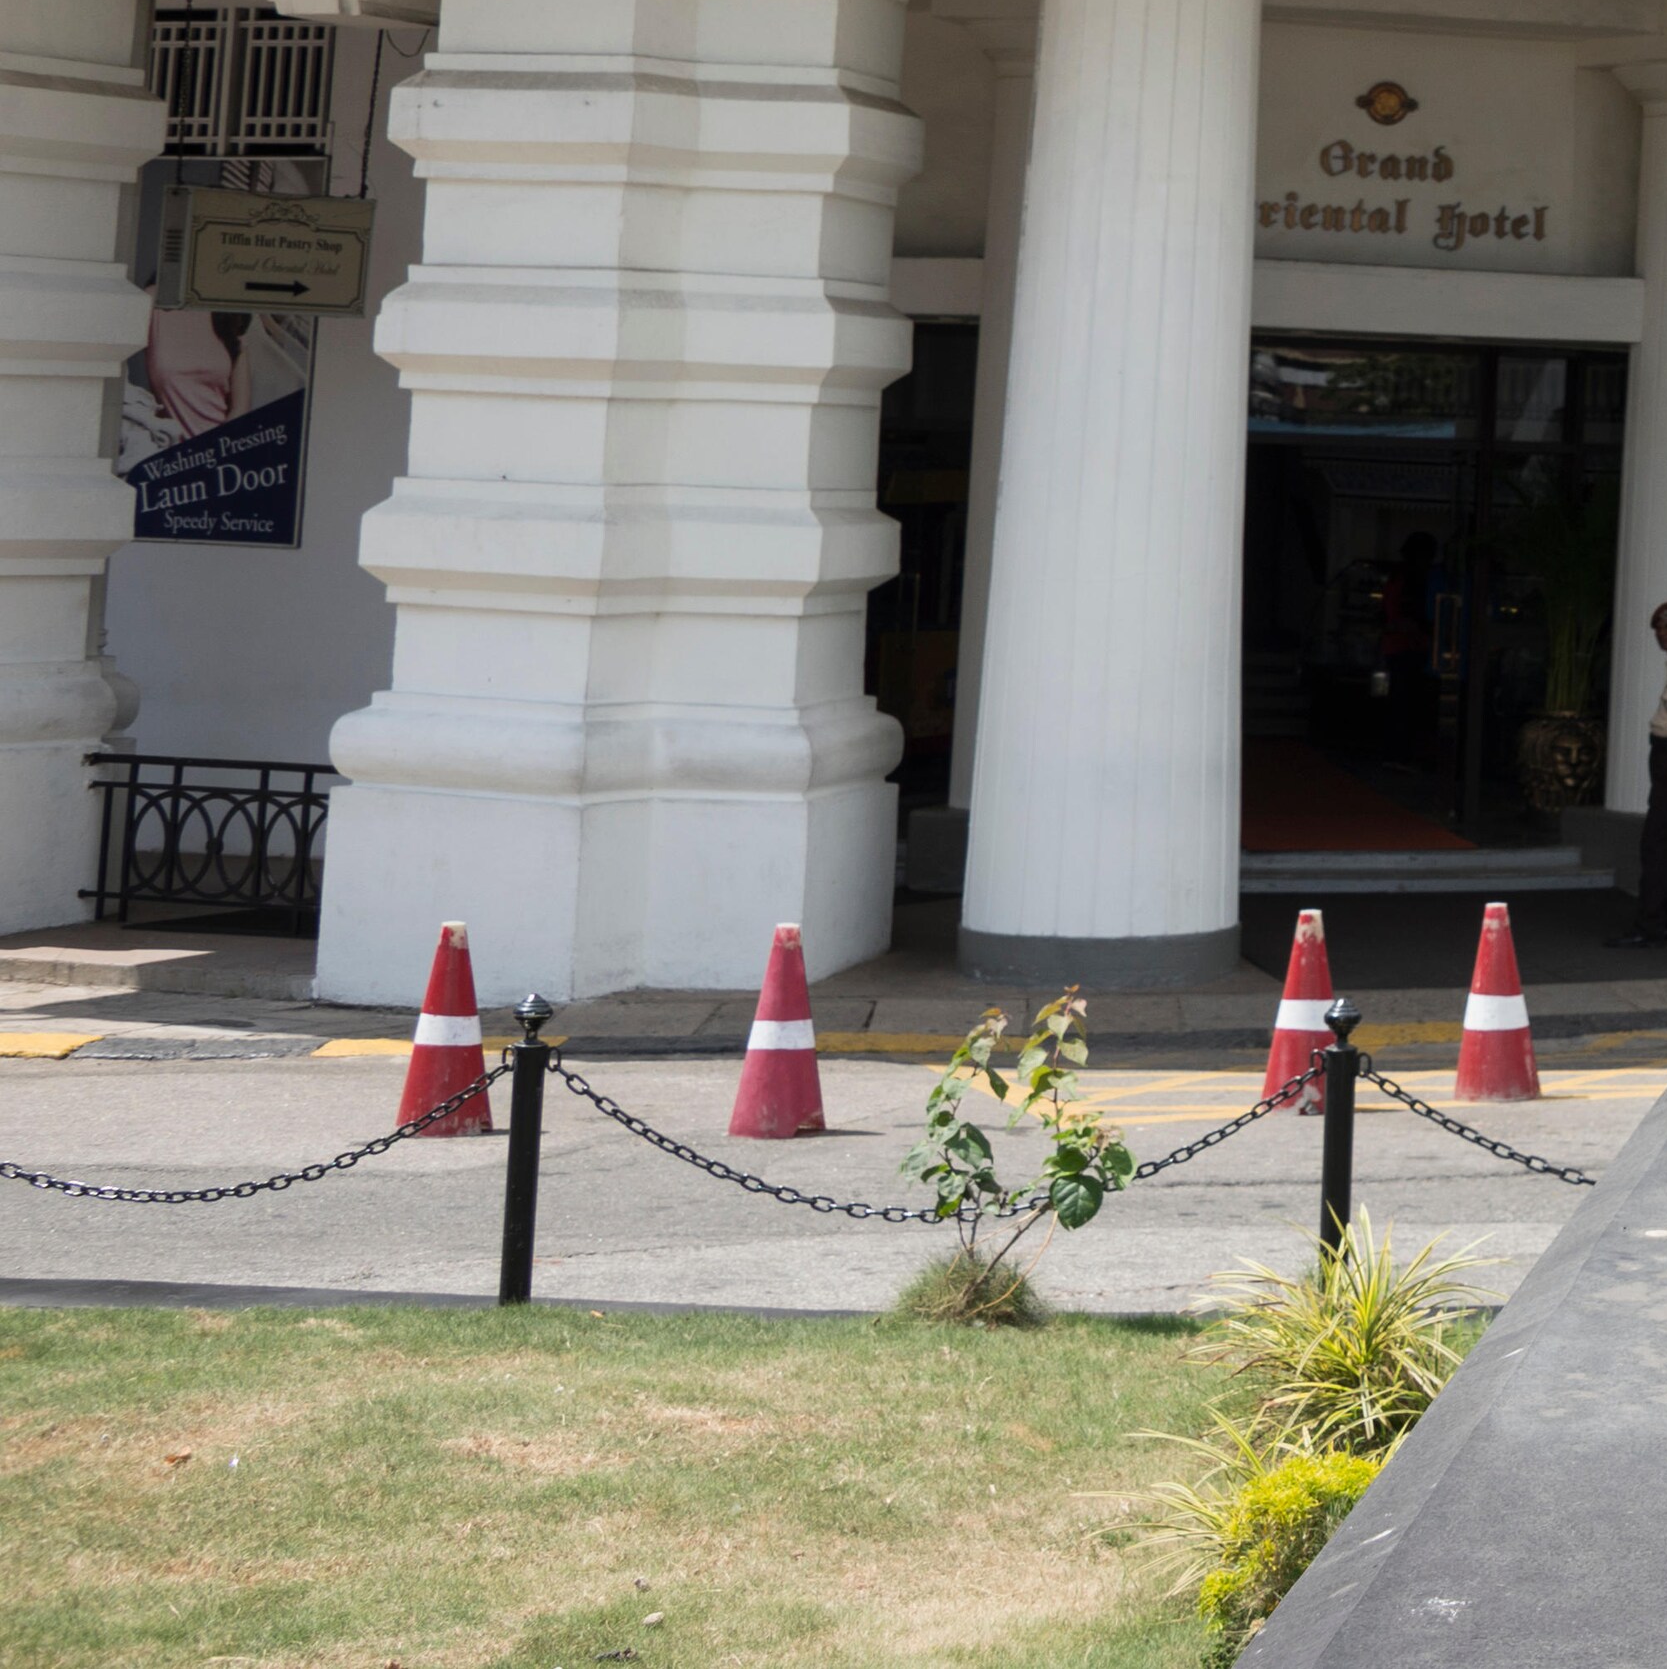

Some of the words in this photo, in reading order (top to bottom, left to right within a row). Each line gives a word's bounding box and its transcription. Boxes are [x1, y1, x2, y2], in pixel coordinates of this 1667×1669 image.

[1319, 139, 1455, 183] Grand
[220, 232, 251, 247] Tiffin
[254, 234, 277, 249] Hut
[278, 236, 313, 253] Pastry
[315, 238, 344, 255] Shop
[1256, 190, 1411, 235] riental
[1432, 201, 1549, 252] Hotel
[143, 447, 217, 481] Washing
[218, 424, 288, 457] Pressing
[139, 480, 209, 513] Laun
[217, 463, 288, 497] Door
[164, 508, 217, 535] Speedy
[220, 511, 275, 533] Service
